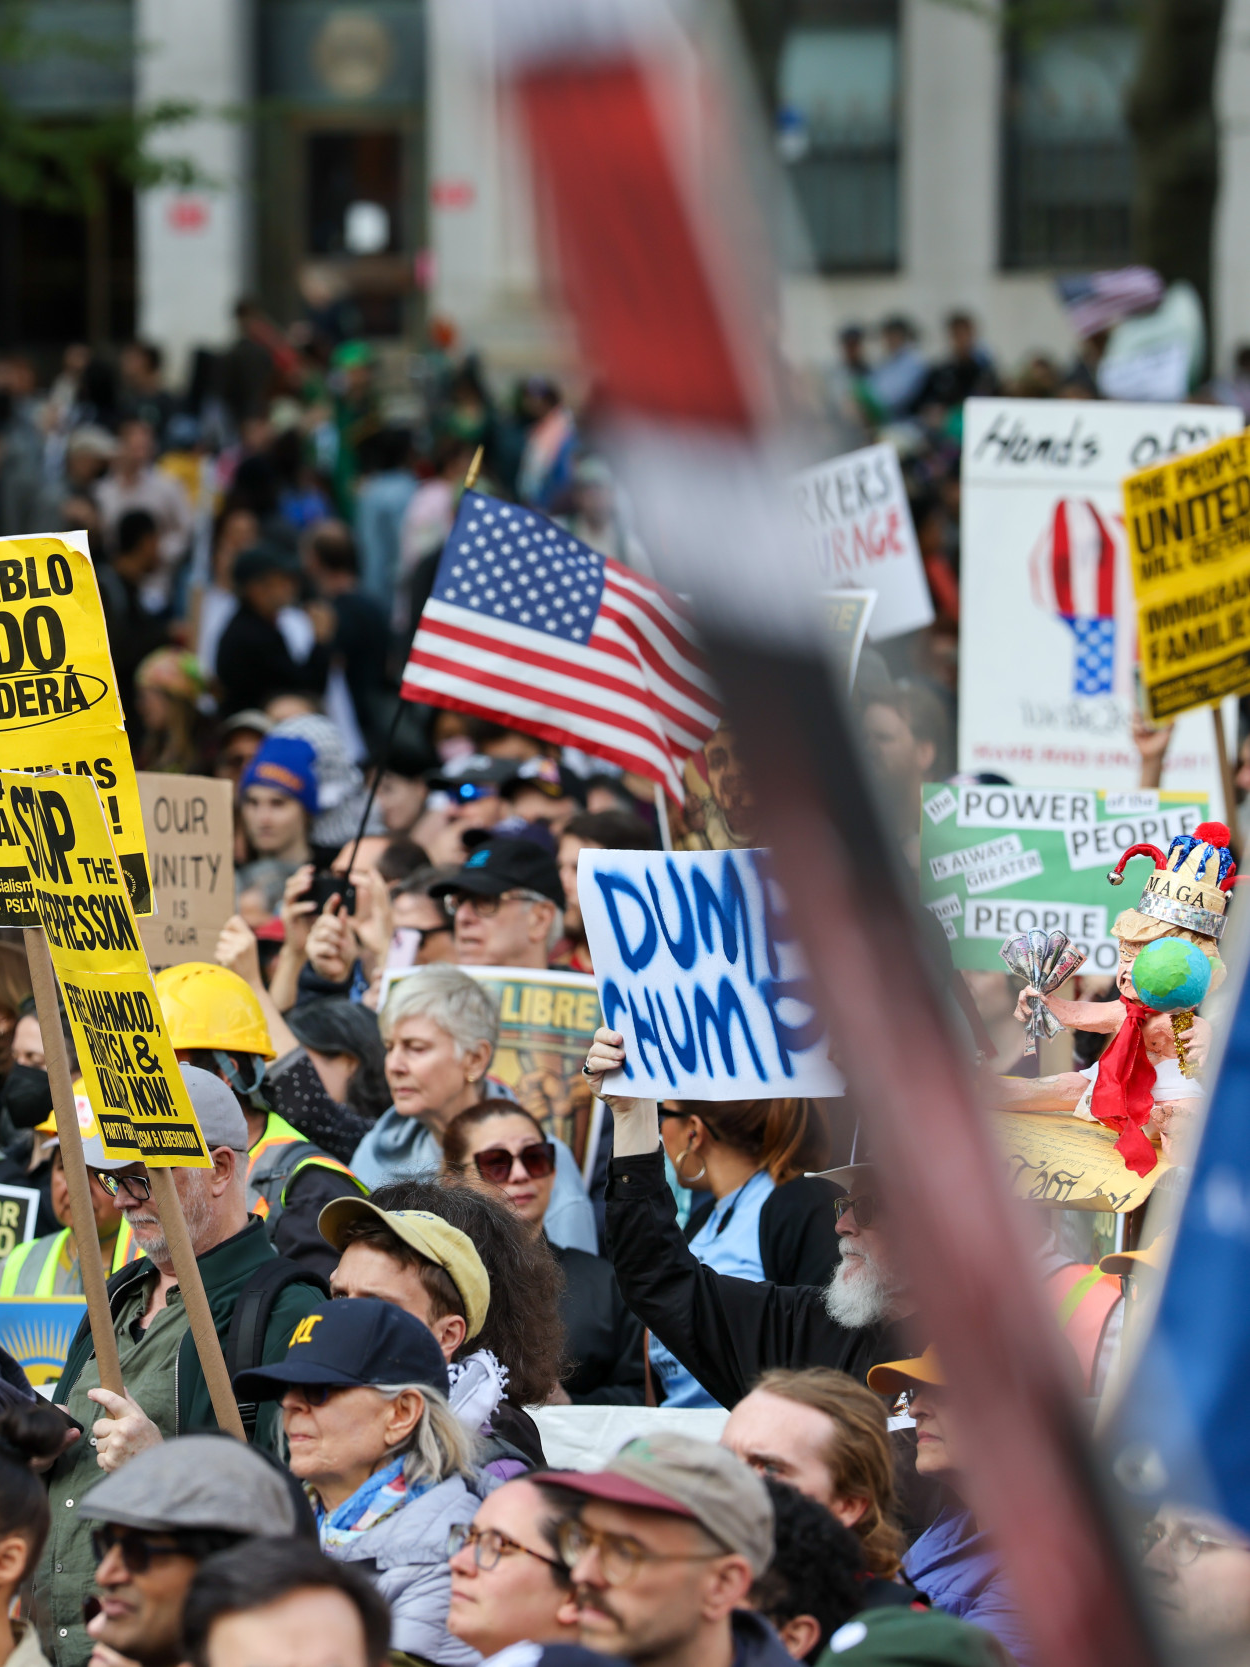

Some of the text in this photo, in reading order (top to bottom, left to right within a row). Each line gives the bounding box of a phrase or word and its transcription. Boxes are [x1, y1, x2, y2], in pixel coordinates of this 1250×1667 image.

[975, 412, 1099, 467] Hands
[1147, 618, 1250, 671] FAMILIE
[153, 796, 210, 836] OUR
[963, 791, 1089, 822] POWER
[1072, 812, 1198, 857] PEOPLE
[76, 857, 119, 885] THE
[951, 840, 1016, 870] ALWAYS
[966, 855, 1038, 888] GREATER
[172, 900, 188, 919] IS
[1145, 876, 1205, 909] MAGA
[164, 925, 199, 946] OUR
[974, 904, 1096, 941] PEOPLE
[501, 983, 599, 1033] LIBRE
[132, 1034, 164, 1075] &
[127, 1075, 179, 1118] NOW!
[102, 1121, 124, 1140] PARTY
[157, 1130, 200, 1149] LIBERATION
[288, 1314, 324, 1349] M
